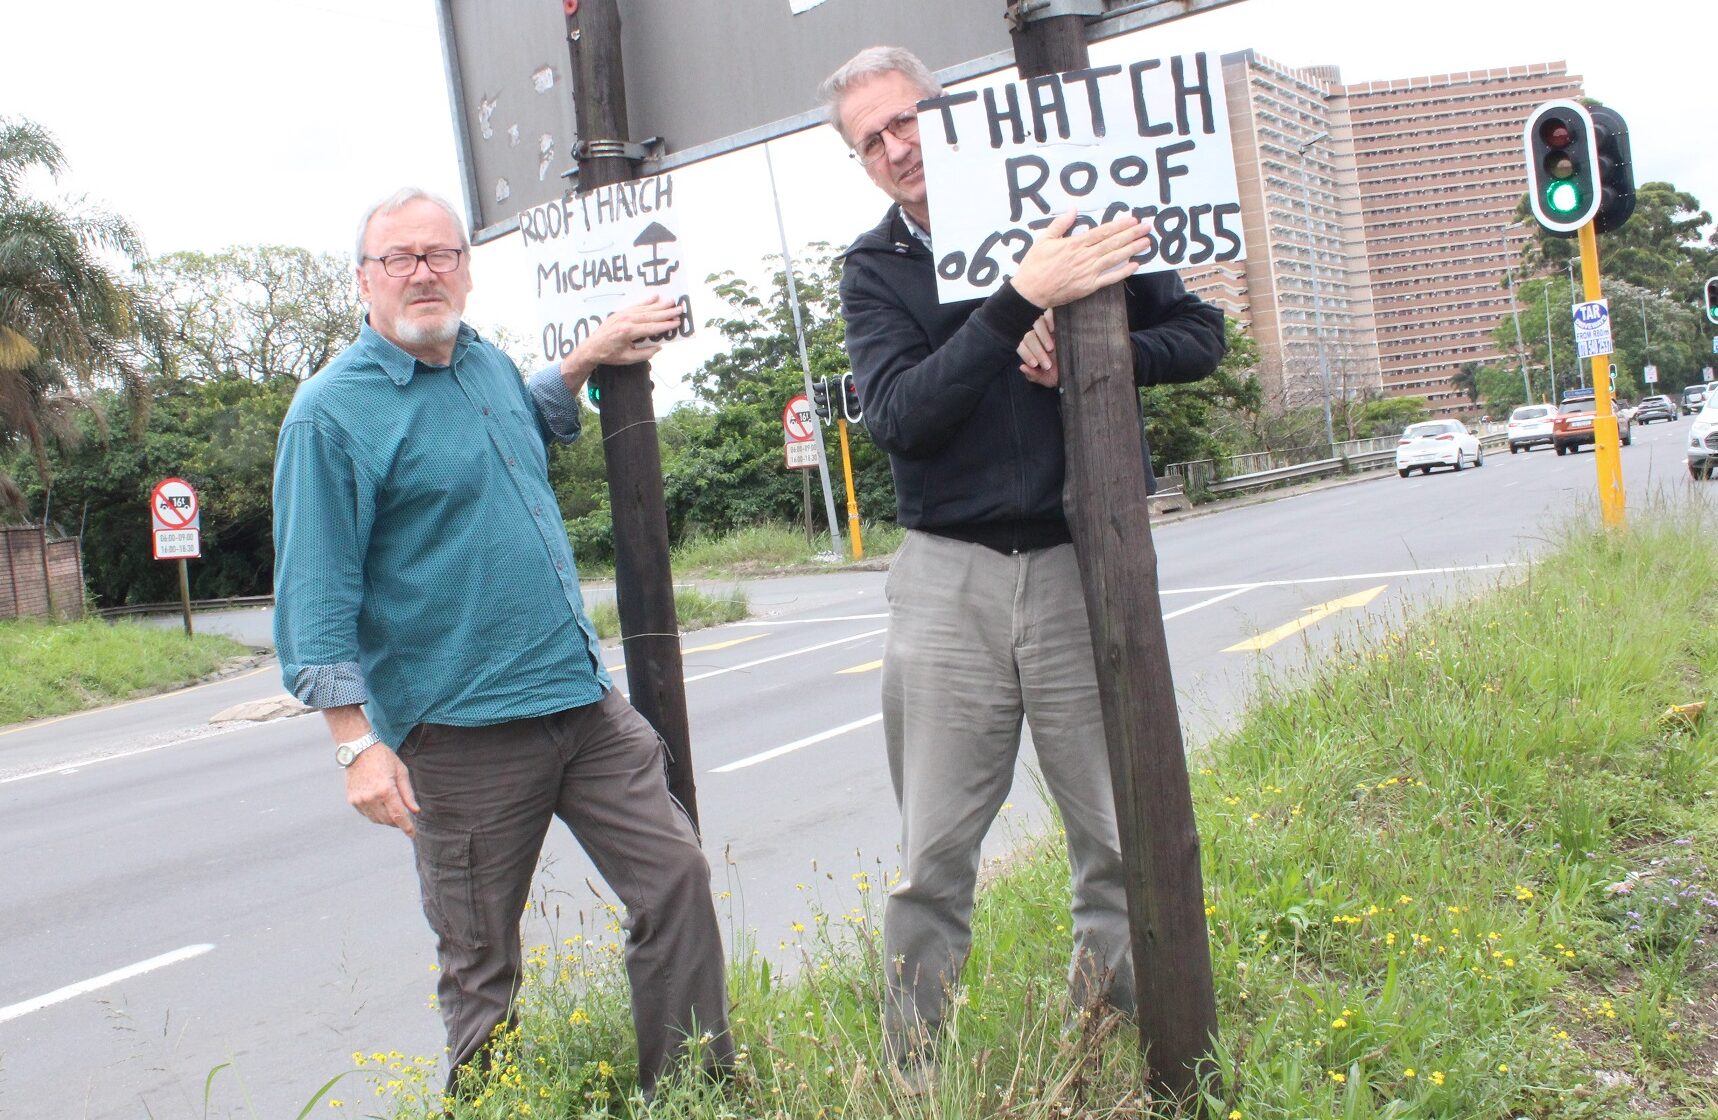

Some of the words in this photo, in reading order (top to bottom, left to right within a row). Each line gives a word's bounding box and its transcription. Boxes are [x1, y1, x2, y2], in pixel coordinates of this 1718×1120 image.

[917, 52, 1215, 148] THATCH
[1005, 140, 1195, 221] ROOF
[1580, 304, 1600, 320] TAR
[172, 497, 185, 507] 16t
